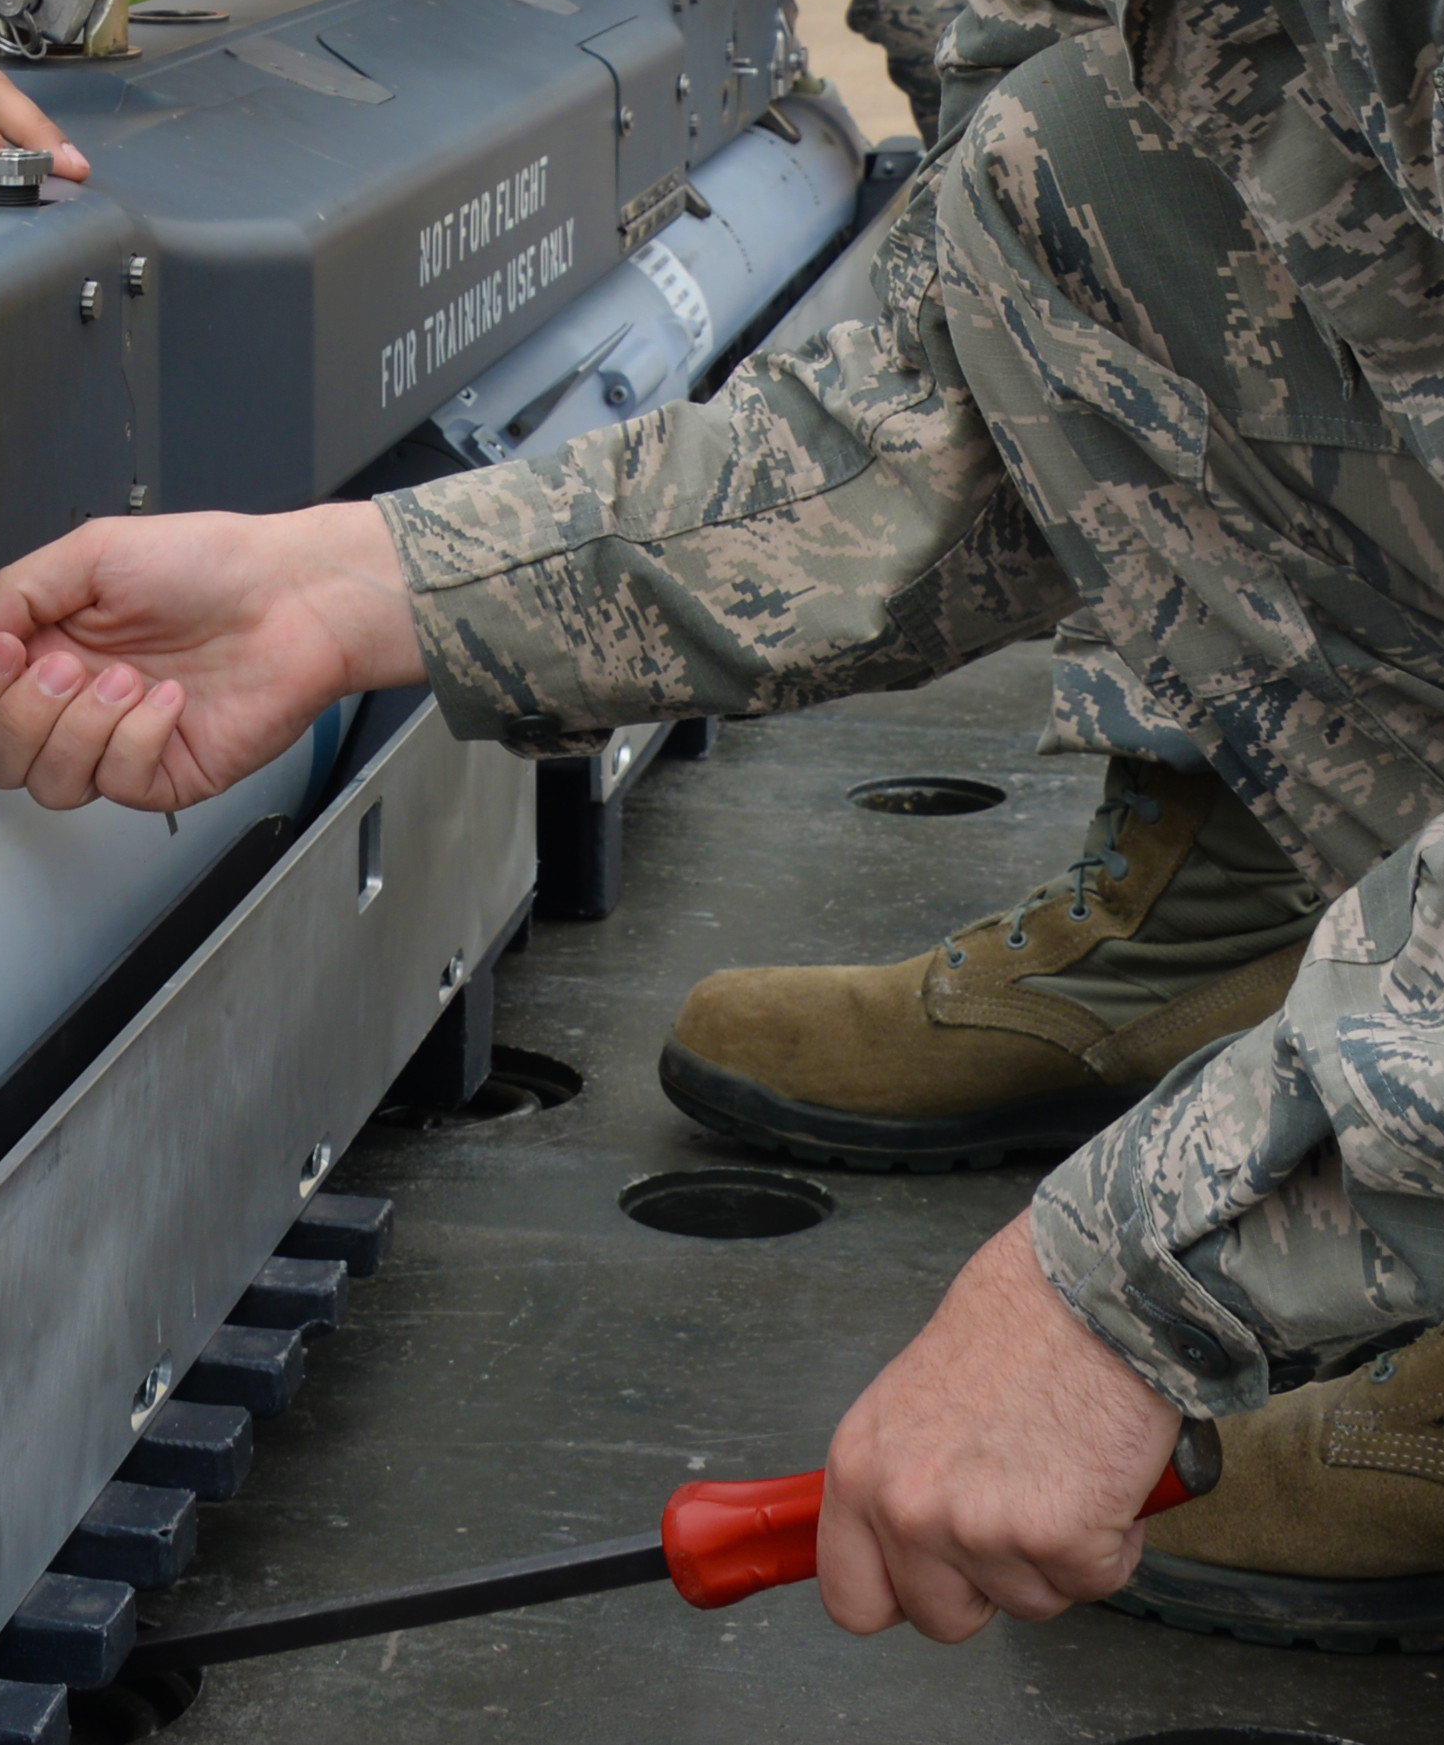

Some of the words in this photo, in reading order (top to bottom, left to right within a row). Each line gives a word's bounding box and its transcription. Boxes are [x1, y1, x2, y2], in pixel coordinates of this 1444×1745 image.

[419, 213, 454, 287] NOT
[460, 191, 490, 261] FOR
[496, 156, 549, 237] FLIGHT
[381, 328, 417, 408] FOR
[424, 270, 502, 375] TRAINING
[507, 245, 536, 313] USE
[540, 216, 575, 288] ONLY
